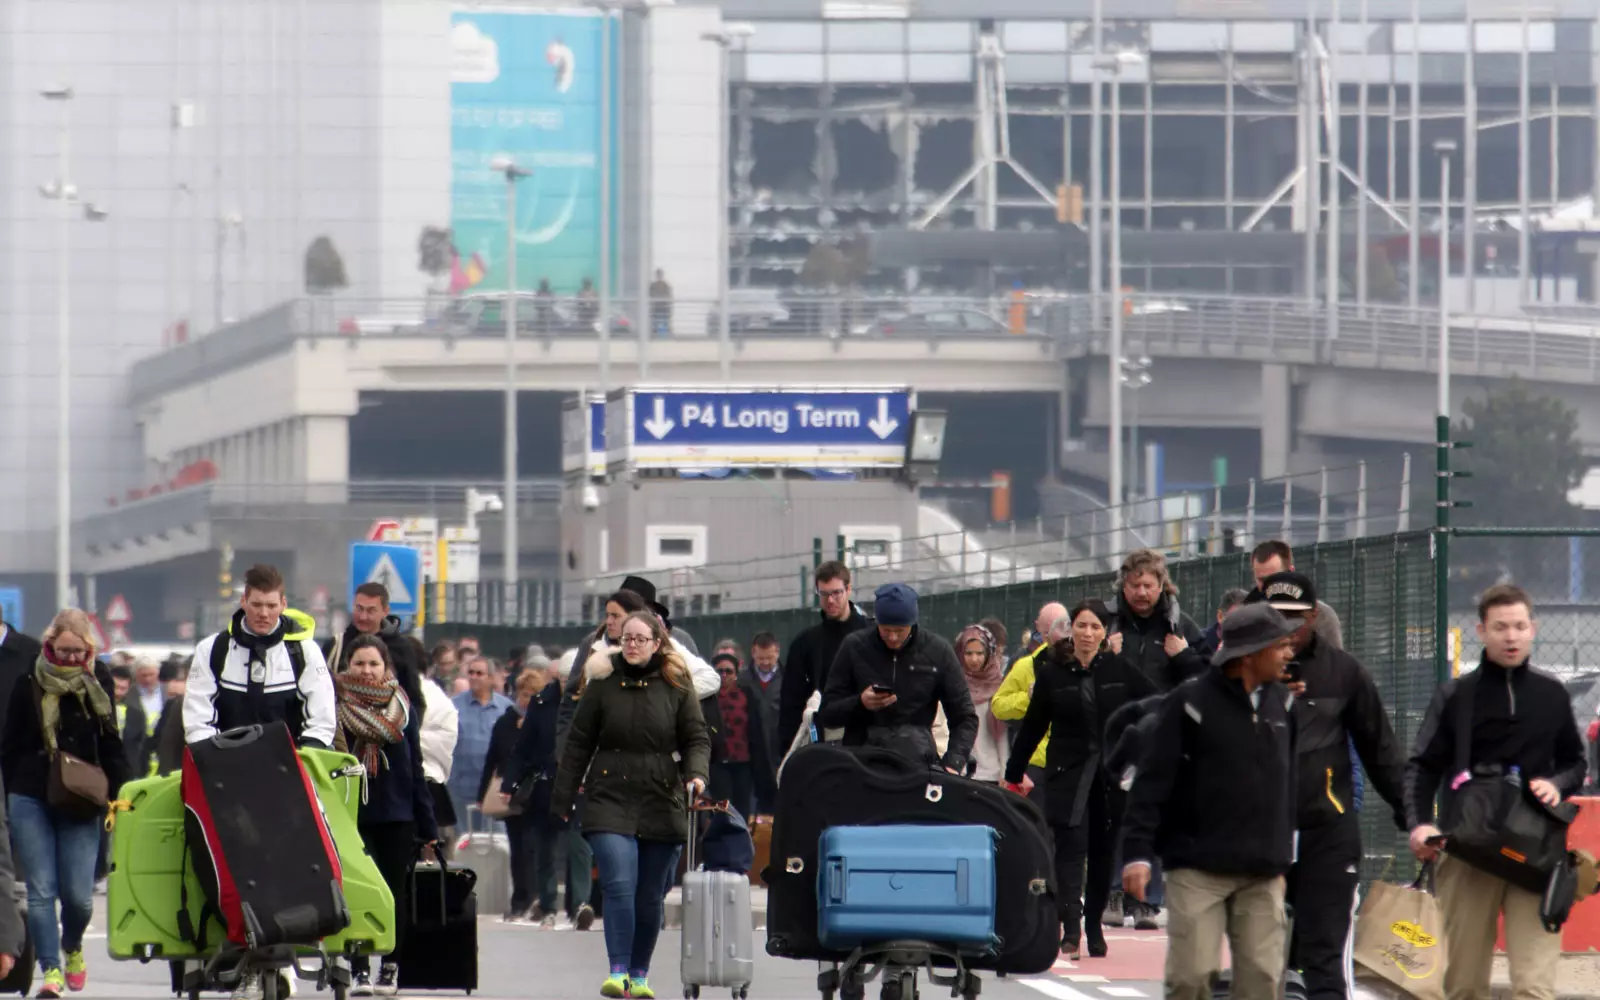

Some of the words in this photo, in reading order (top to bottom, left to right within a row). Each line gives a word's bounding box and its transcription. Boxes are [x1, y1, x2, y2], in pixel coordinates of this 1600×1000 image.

[682, 404, 717, 428] P4
[722, 404, 789, 433] Long
[796, 404, 860, 428] Term
[1265, 581, 1304, 600] BROOKLYN
